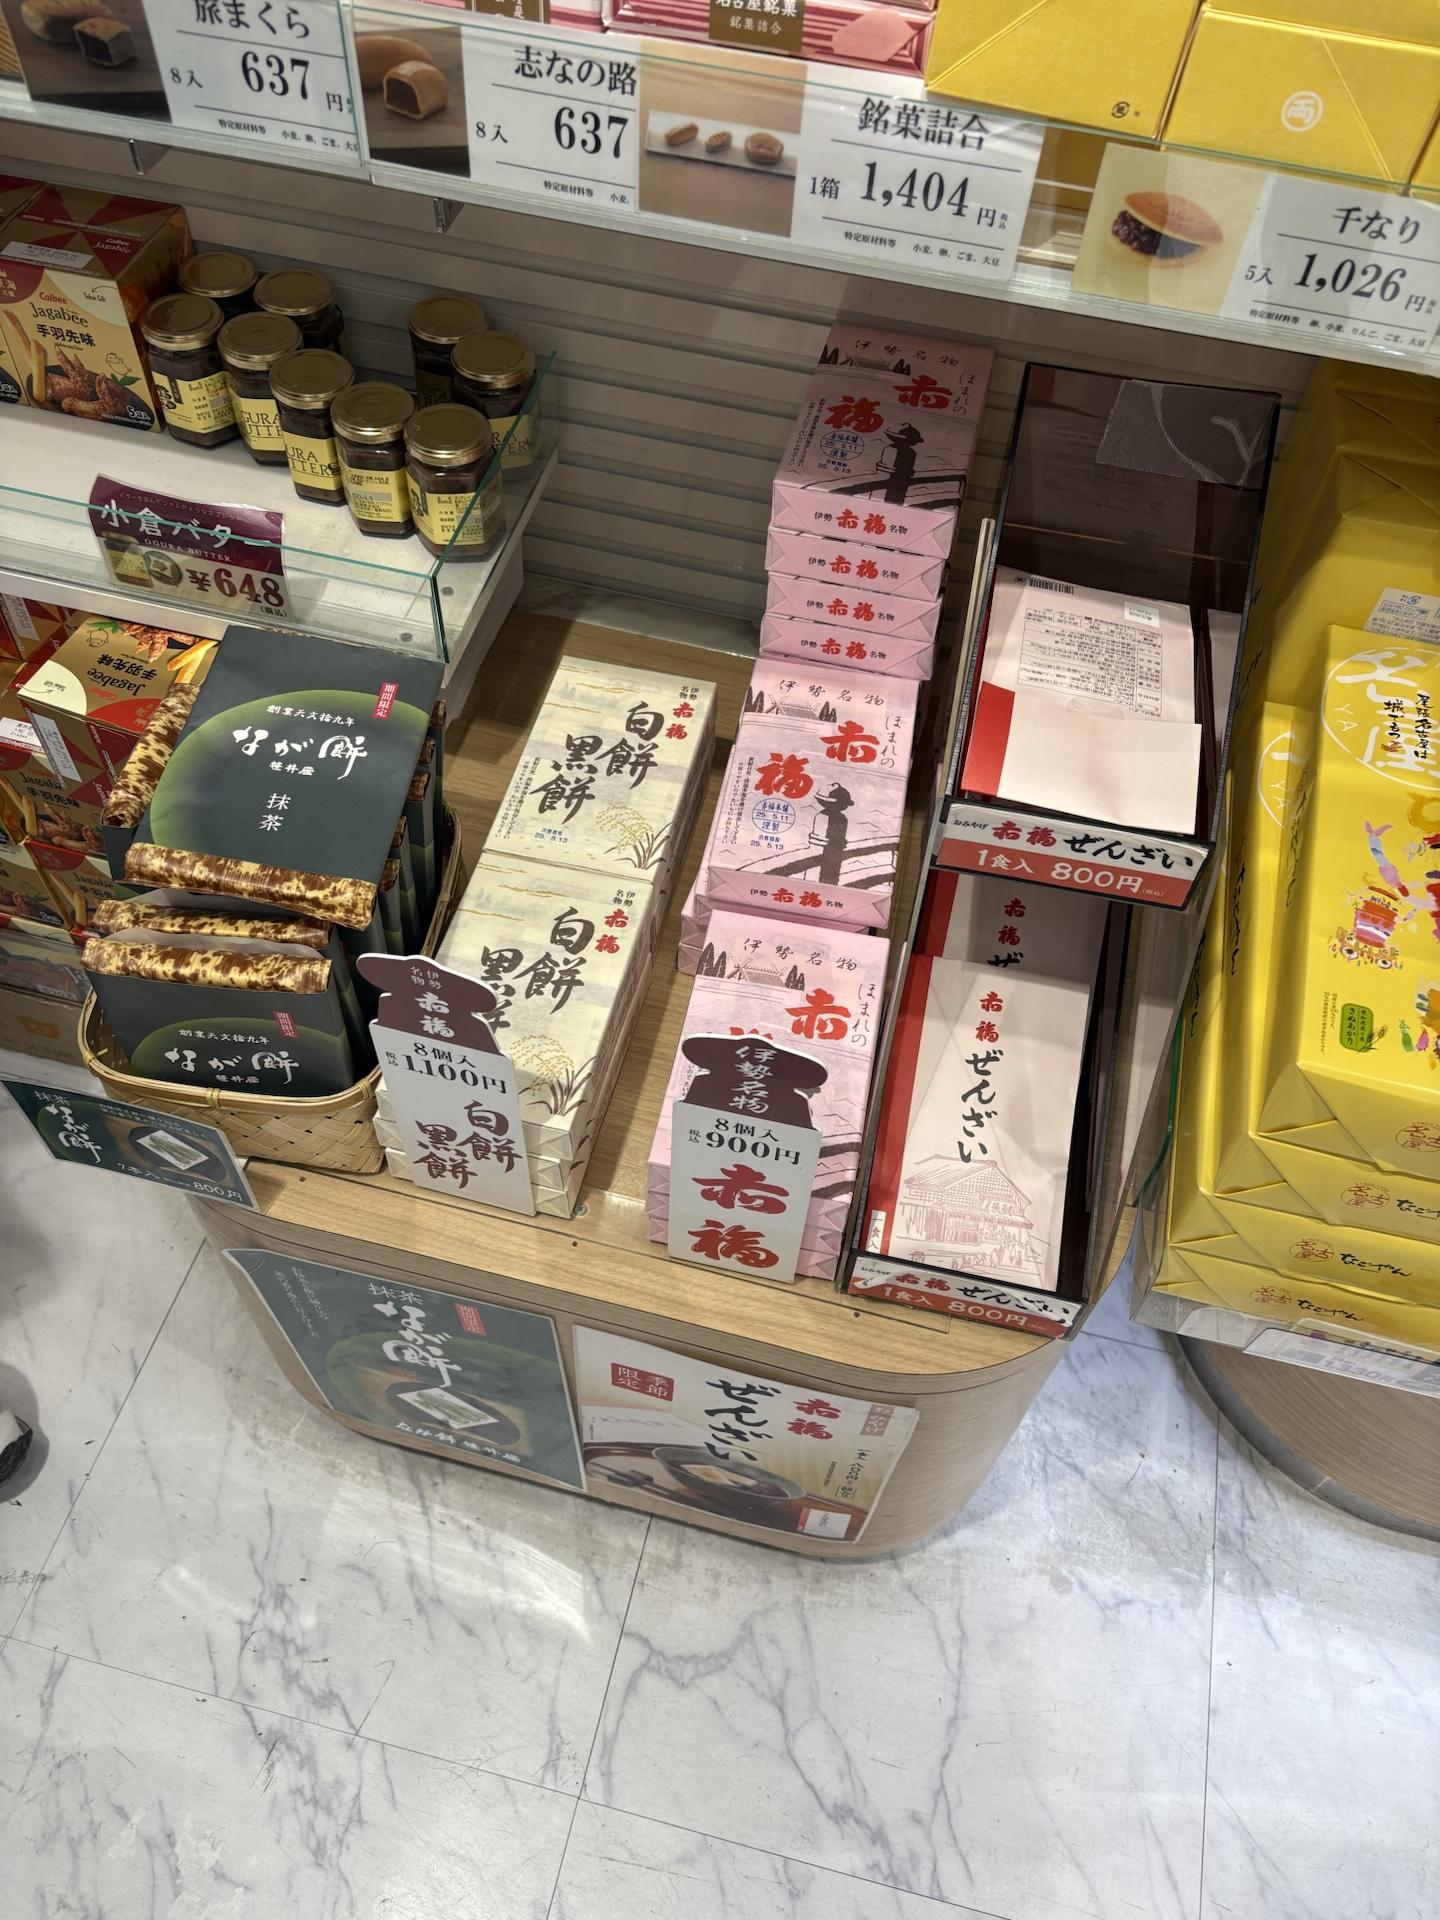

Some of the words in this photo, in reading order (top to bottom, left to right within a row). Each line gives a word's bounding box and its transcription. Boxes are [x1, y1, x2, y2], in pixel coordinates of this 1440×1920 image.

[194, 0, 311, 39] 旅まくら
[169, 67, 204, 89] 8入
[513, 44, 638, 97] 志なの路
[475, 120, 509, 144] 8入
[554, 106, 629, 159] 637
[858, 97, 992, 152] 銘菓詰合
[1333, 205, 1422, 244] 千なり
[29, 302, 89, 328] Jagabee
[39, 291, 68, 305] Calbee
[36, 323, 97, 347] 手羽先味
[824, 373, 954, 434] 赤福
[184, 567, 285, 608] ¥648
[85, 667, 147, 697] Jagabee
[95, 653, 158, 681] 手羽先味
[779, 679, 885, 707] 伊勢名物
[664, 701, 696, 740] 赤福
[879, 714, 902, 769] ほまれの
[594, 700, 665, 790] 白餅
[753, 719, 881, 800] 赤福
[528, 733, 604, 825] 黒餅
[259, 792, 292, 832] 抹茶
[991, 820, 1058, 847] 赤福
[1062, 832, 1194, 870] ぜんざい
[977, 848, 1035, 875] 1食入
[1050, 861, 1144, 894] 800円
[594, 908, 630, 954] 赤福
[997, 897, 1027, 946] 赤福
[743, 937, 858, 972] 伊勢名物
[414, 991, 456, 1039] 赤福
[850, 982, 876, 1048] ほまれの
[974, 990, 1004, 1044] 赤福
[402, 1053, 508, 1095] 1,100円
[413, 1042, 477, 1069] 8個入
[728, 1044, 778, 1114] 伊勢名物
[956, 1048, 1005, 1163] ぜんざい
[456, 1099, 523, 1174] 白餅
[704, 1130, 802, 1167] 900円
[713, 1117, 780, 1143] 8個入
[412, 1119, 479, 1190] 黒餅
[687, 1163, 791, 1269] 赤福
[947, 1300, 1029, 1327] 800円
[703, 1378, 782, 1463] ぜんざい
[786, 1397, 842, 1441] 赤福
